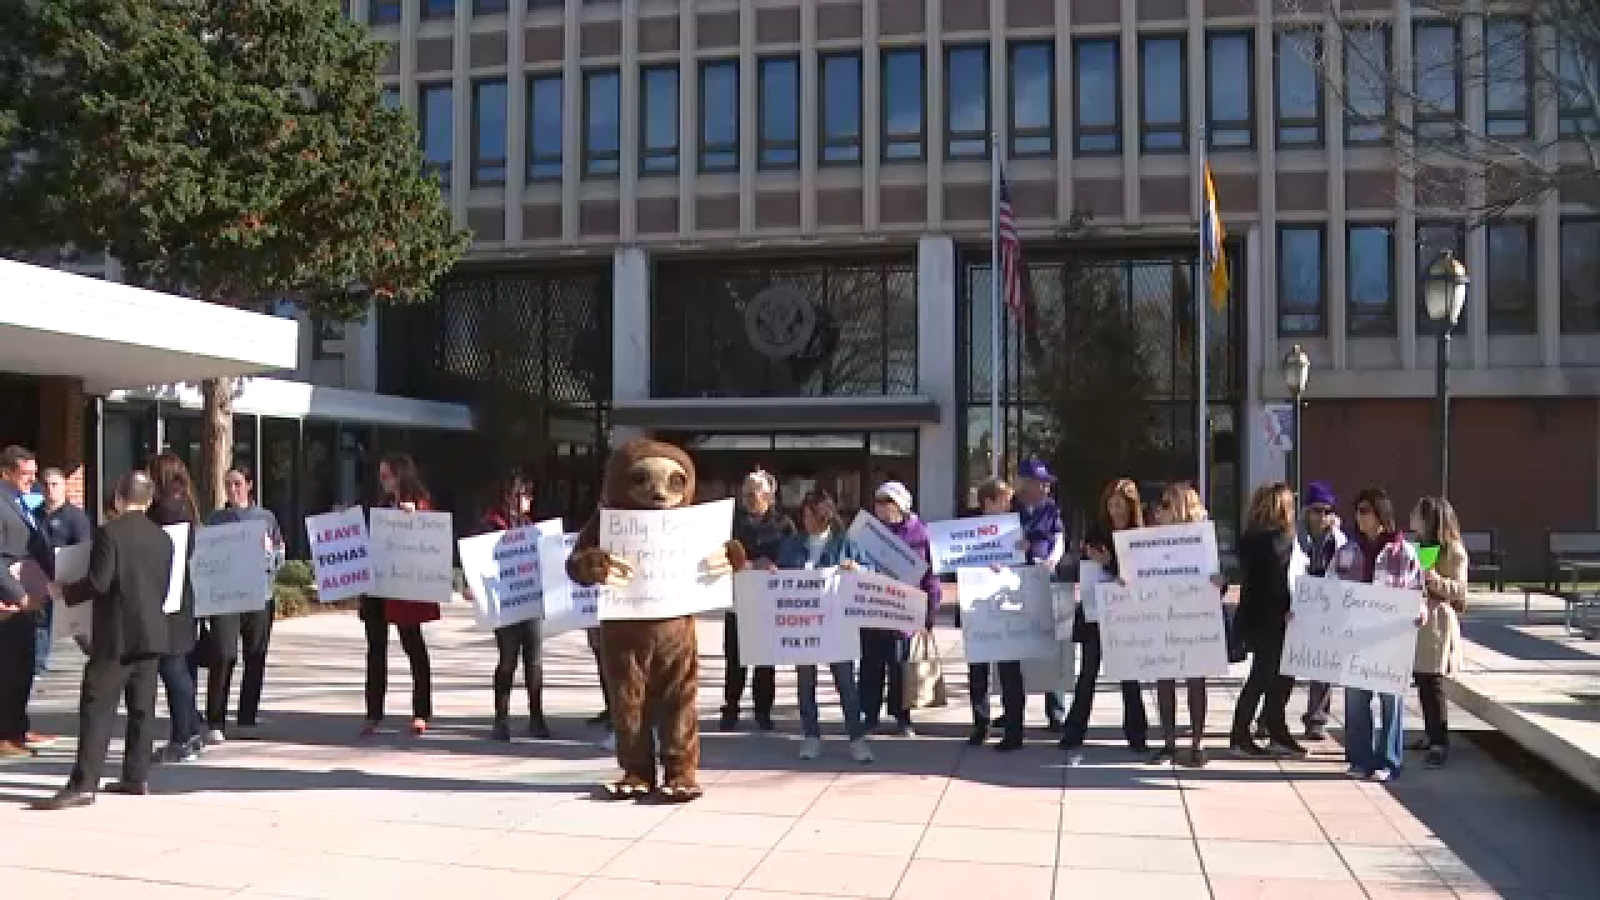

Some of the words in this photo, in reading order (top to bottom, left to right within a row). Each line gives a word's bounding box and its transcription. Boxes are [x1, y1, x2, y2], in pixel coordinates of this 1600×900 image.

[317, 524, 361, 543] LEAVE
[608, 514, 648, 543] Billy
[976, 524, 998, 537] NO
[322, 567, 371, 590] ALONE
[781, 579, 793, 590] IT
[775, 597, 818, 608] BROKE
[1296, 582, 1331, 612] Billy
[774, 614, 824, 628] DON'T
[780, 636, 800, 648] FIX
